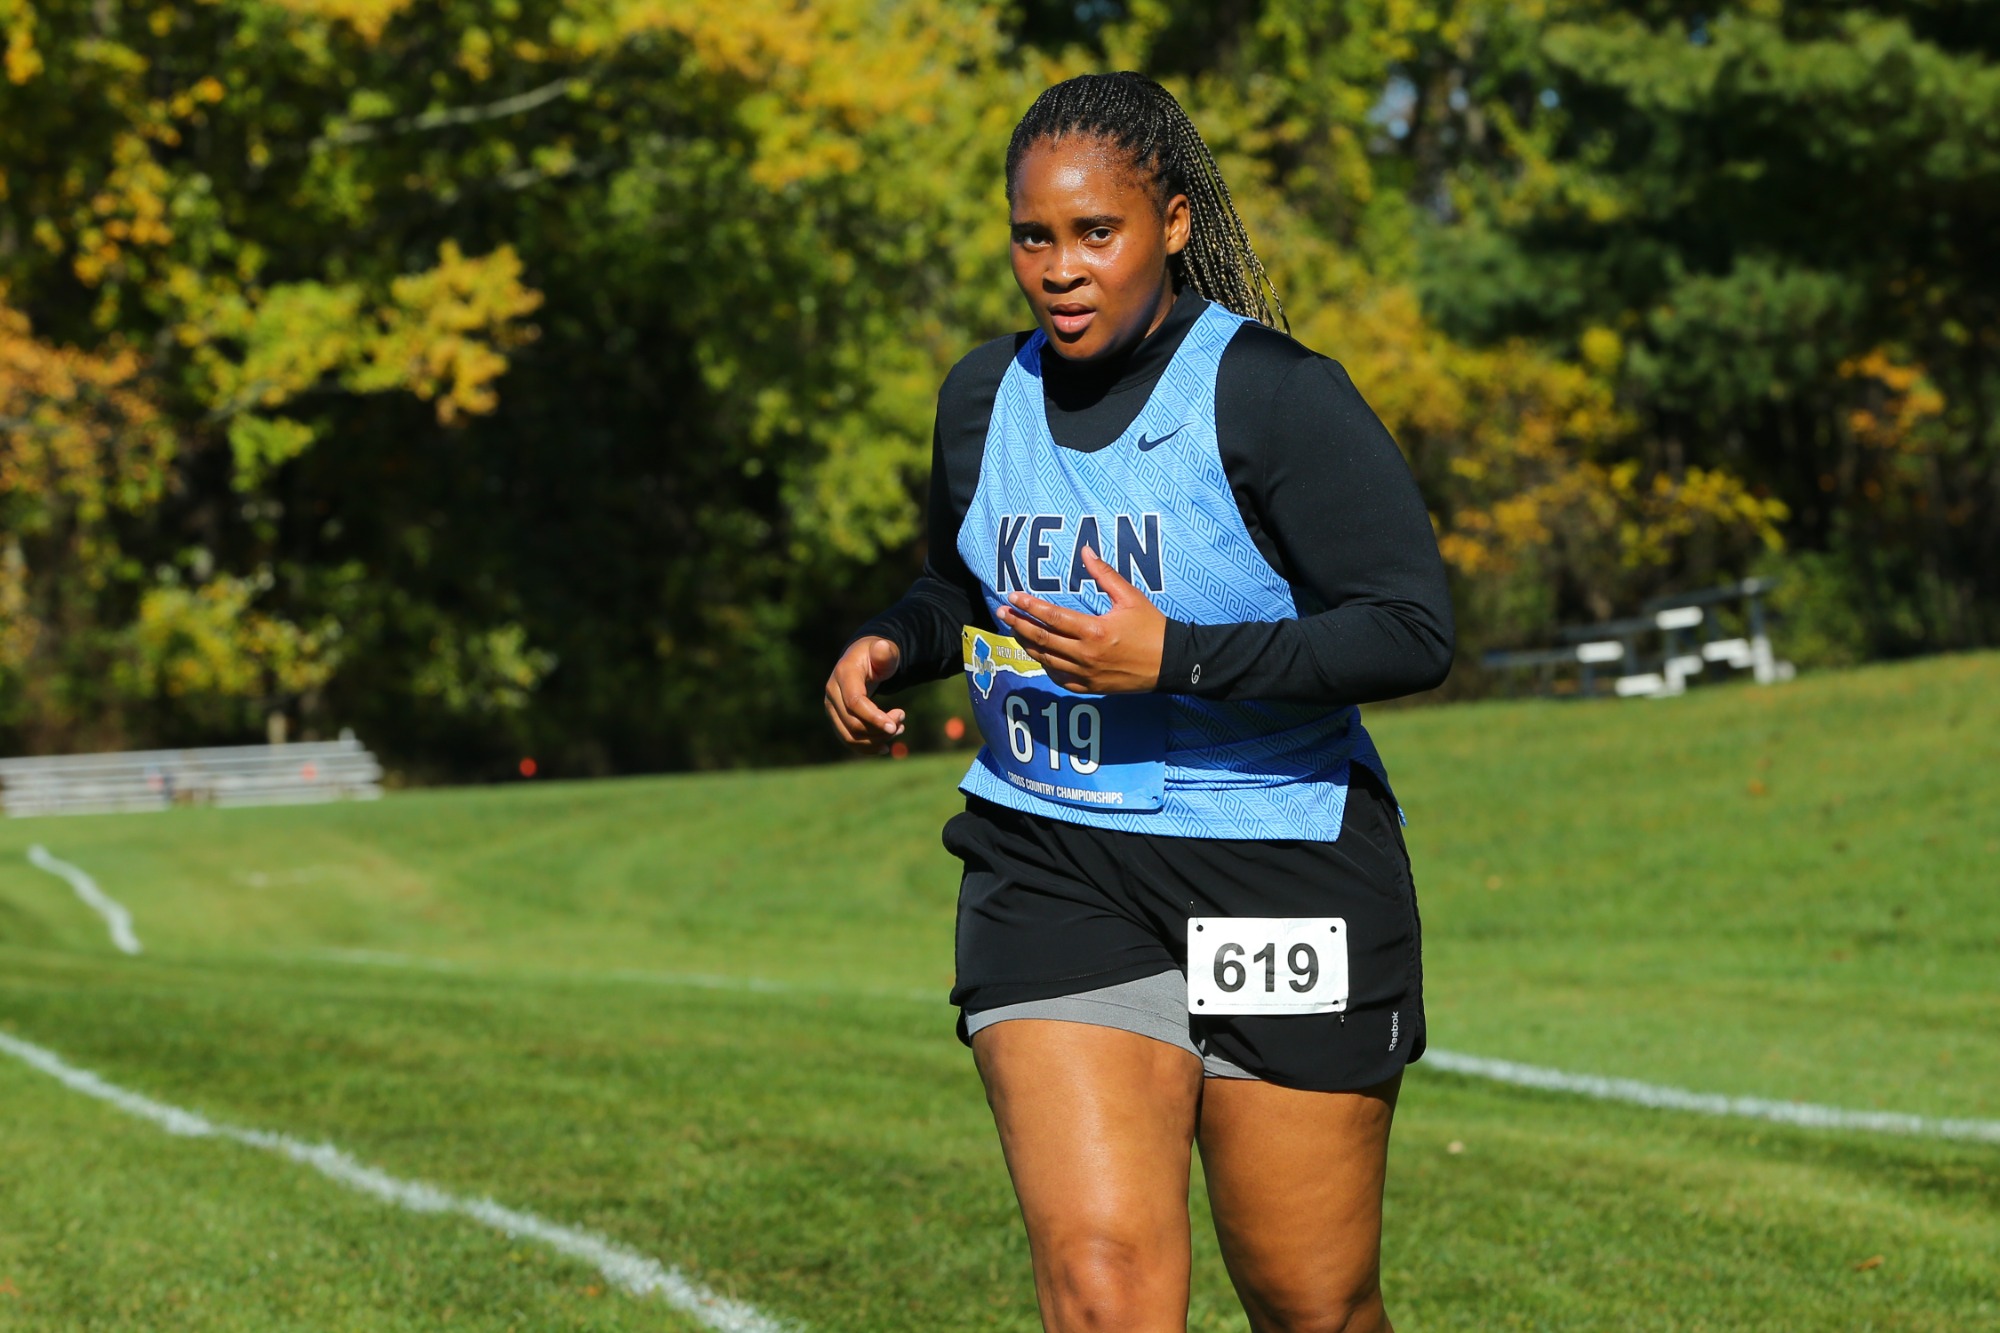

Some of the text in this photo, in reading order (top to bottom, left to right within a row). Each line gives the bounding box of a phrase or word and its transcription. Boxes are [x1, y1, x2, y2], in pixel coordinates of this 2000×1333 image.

[996, 514, 1165, 594] KEAN
[996, 646, 1012, 659] NEW
[1006, 695, 1101, 775] 619
[1007, 771, 1124, 804] CROSS COUNTRY CHAMPIONSHIPS
[1213, 942, 1319, 993] 619
[1389, 1011, 1399, 1051] Reebok
